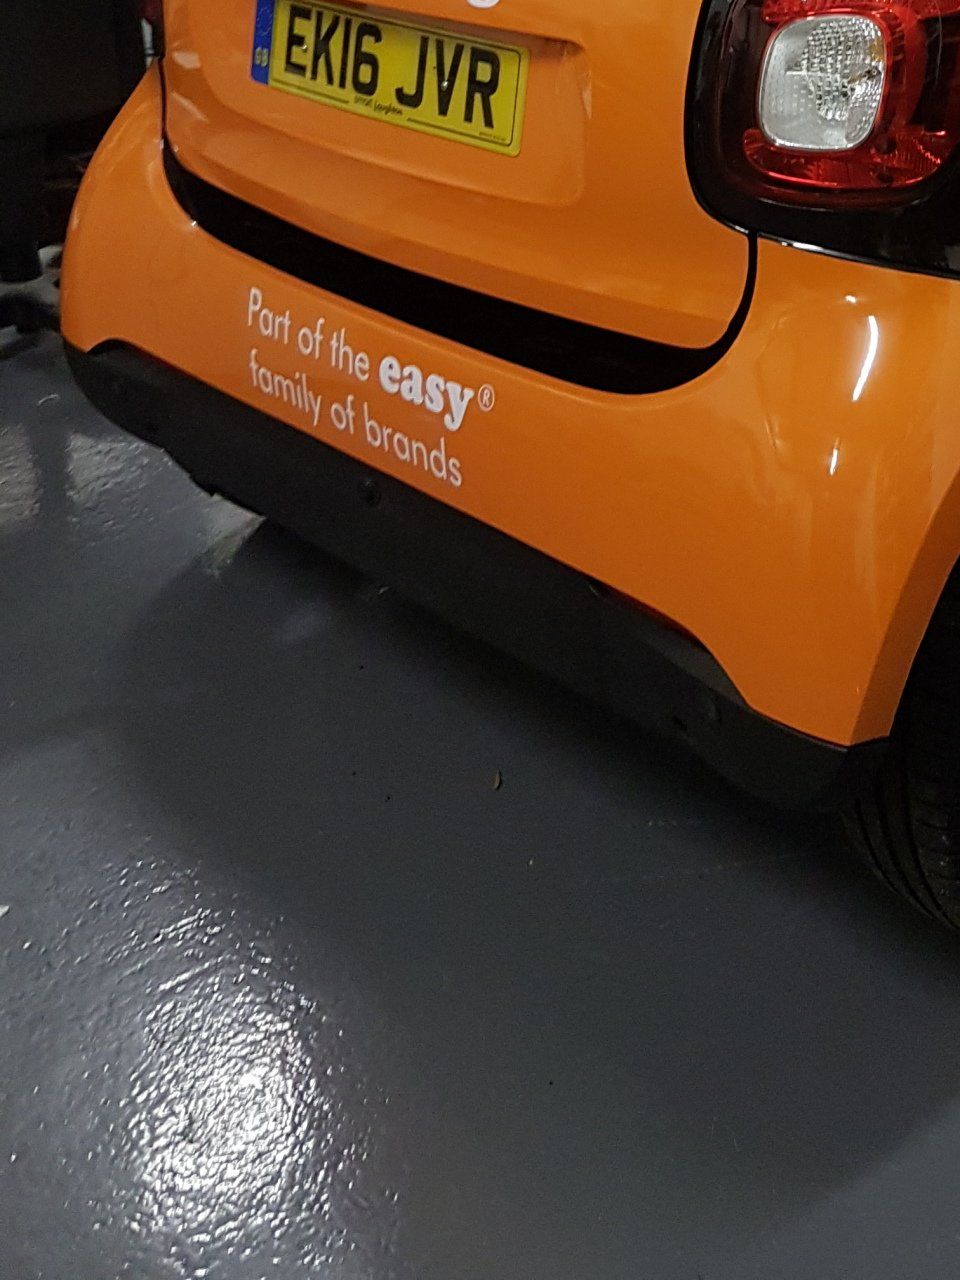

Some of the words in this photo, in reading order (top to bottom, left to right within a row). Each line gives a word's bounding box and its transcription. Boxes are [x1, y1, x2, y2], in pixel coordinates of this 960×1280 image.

[285, 4, 382, 96] EK16
[395, 35, 499, 129] JVR
[247, 286, 291, 344] Part
[297, 317, 325, 359] of
[331, 328, 370, 382] the
[249, 348, 322, 427] family
[330, 394, 356, 435] of
[363, 402, 462, 487] brands
